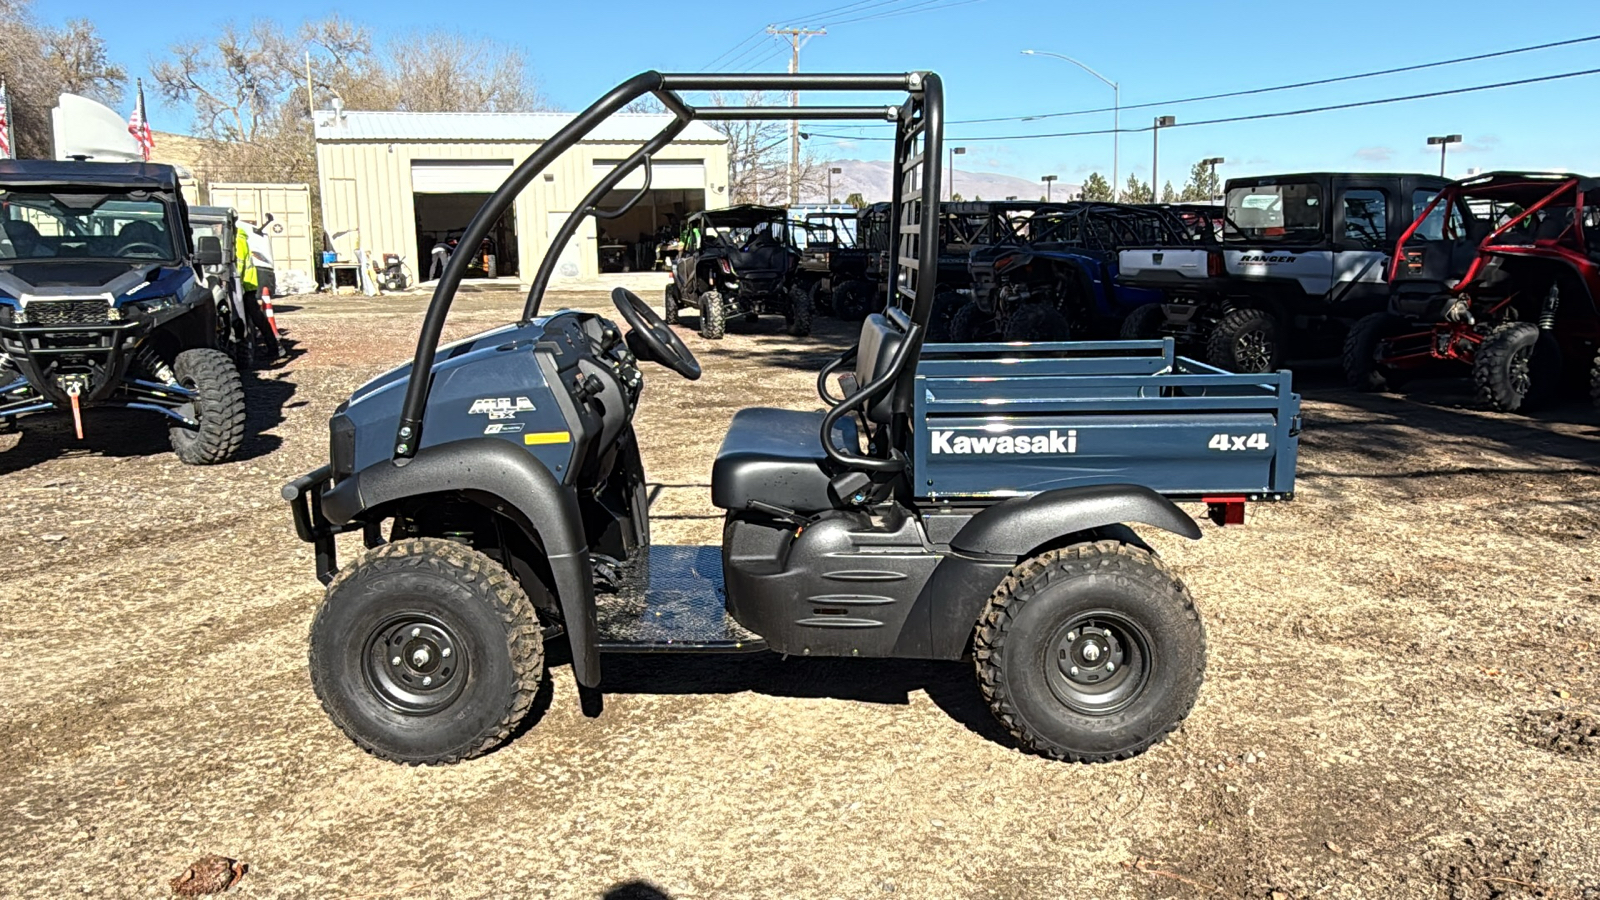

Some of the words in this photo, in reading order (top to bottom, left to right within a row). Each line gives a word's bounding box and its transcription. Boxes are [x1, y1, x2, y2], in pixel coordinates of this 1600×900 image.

[1240, 255, 1297, 263] RANGER
[931, 430, 1077, 454] Kawasaki
[1208, 433, 1270, 451] 4x4
